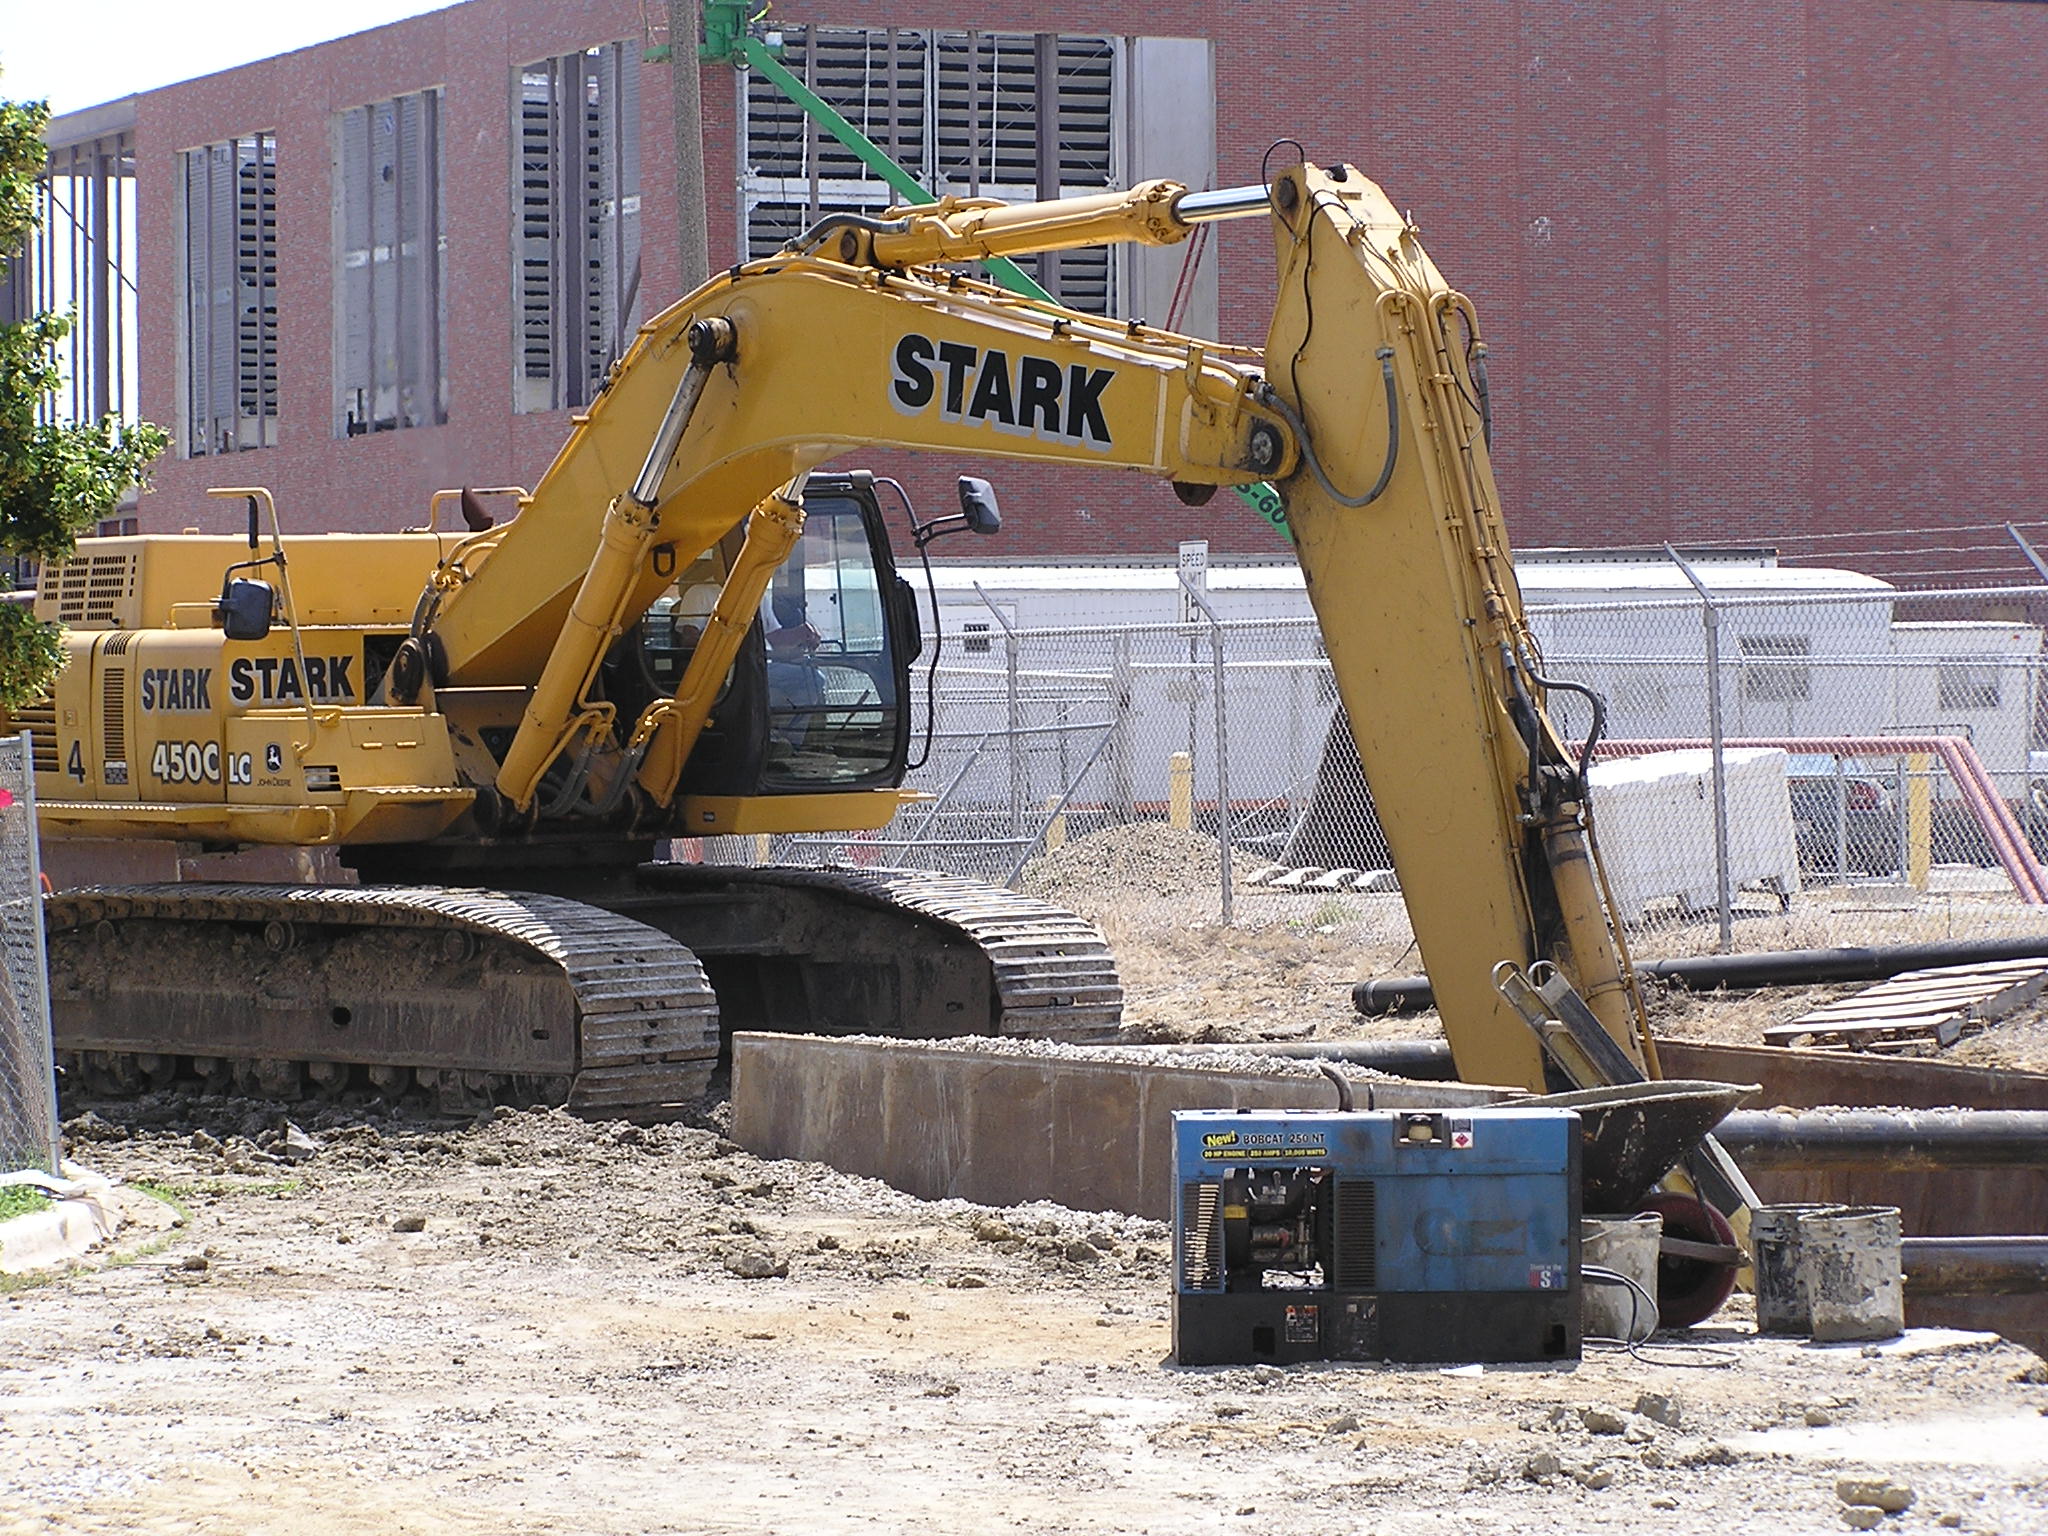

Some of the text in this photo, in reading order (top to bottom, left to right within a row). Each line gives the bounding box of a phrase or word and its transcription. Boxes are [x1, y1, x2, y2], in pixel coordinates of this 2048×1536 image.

[891, 333, 1116, 447] STARK
[1182, 552, 1205, 567] SPEED
[142, 668, 212, 712] STARK
[230, 657, 356, 704] STARK
[68, 740, 86, 783] 4
[152, 740, 221, 785] 450C
[228, 752, 251, 785] LC
[1206, 1130, 1325, 1147] New! BOBCAT 250 NT
[1529, 1270, 1562, 1288] USA
